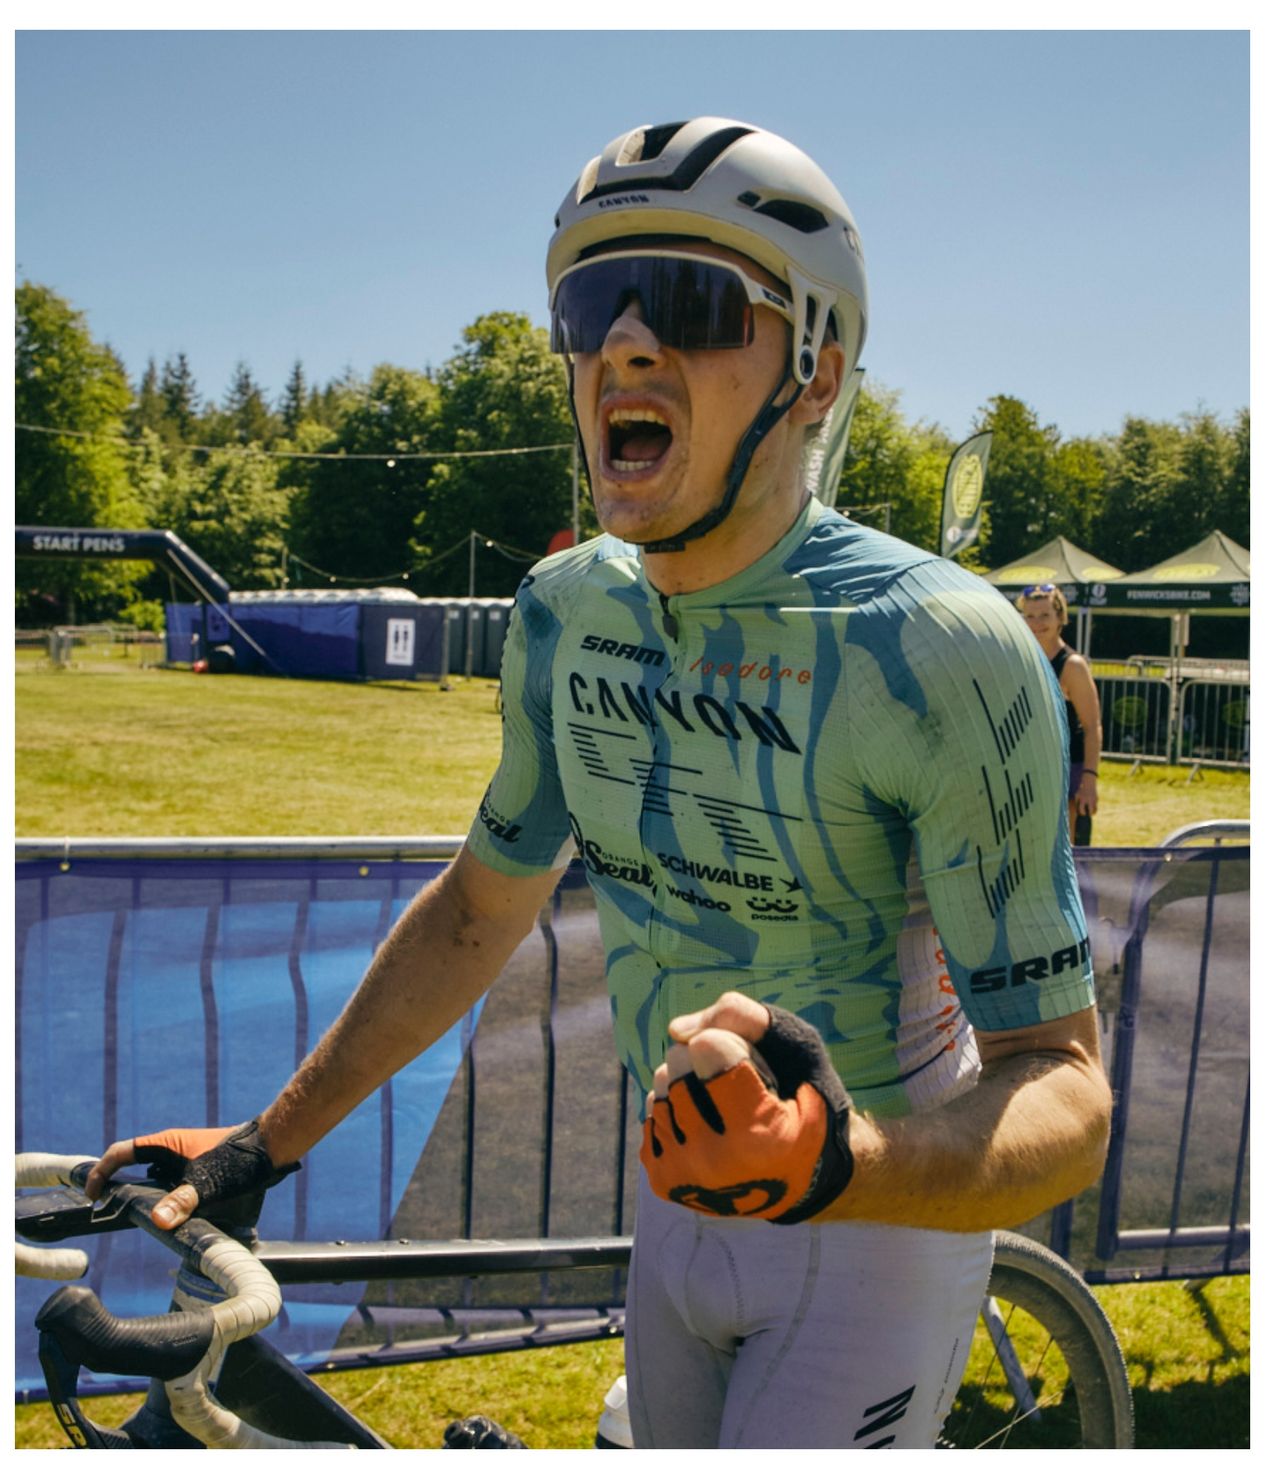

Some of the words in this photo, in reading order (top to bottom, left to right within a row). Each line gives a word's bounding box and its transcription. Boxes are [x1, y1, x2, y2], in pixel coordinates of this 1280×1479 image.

[599, 194, 650, 209] CANYON
[33, 534, 80, 551] START
[82, 537, 125, 552] PENS
[581, 635, 665, 667] SRAM
[569, 671, 803, 756] CANYON
[657, 852, 775, 892] SCHWALBE
[666, 884, 732, 912] wahoo
